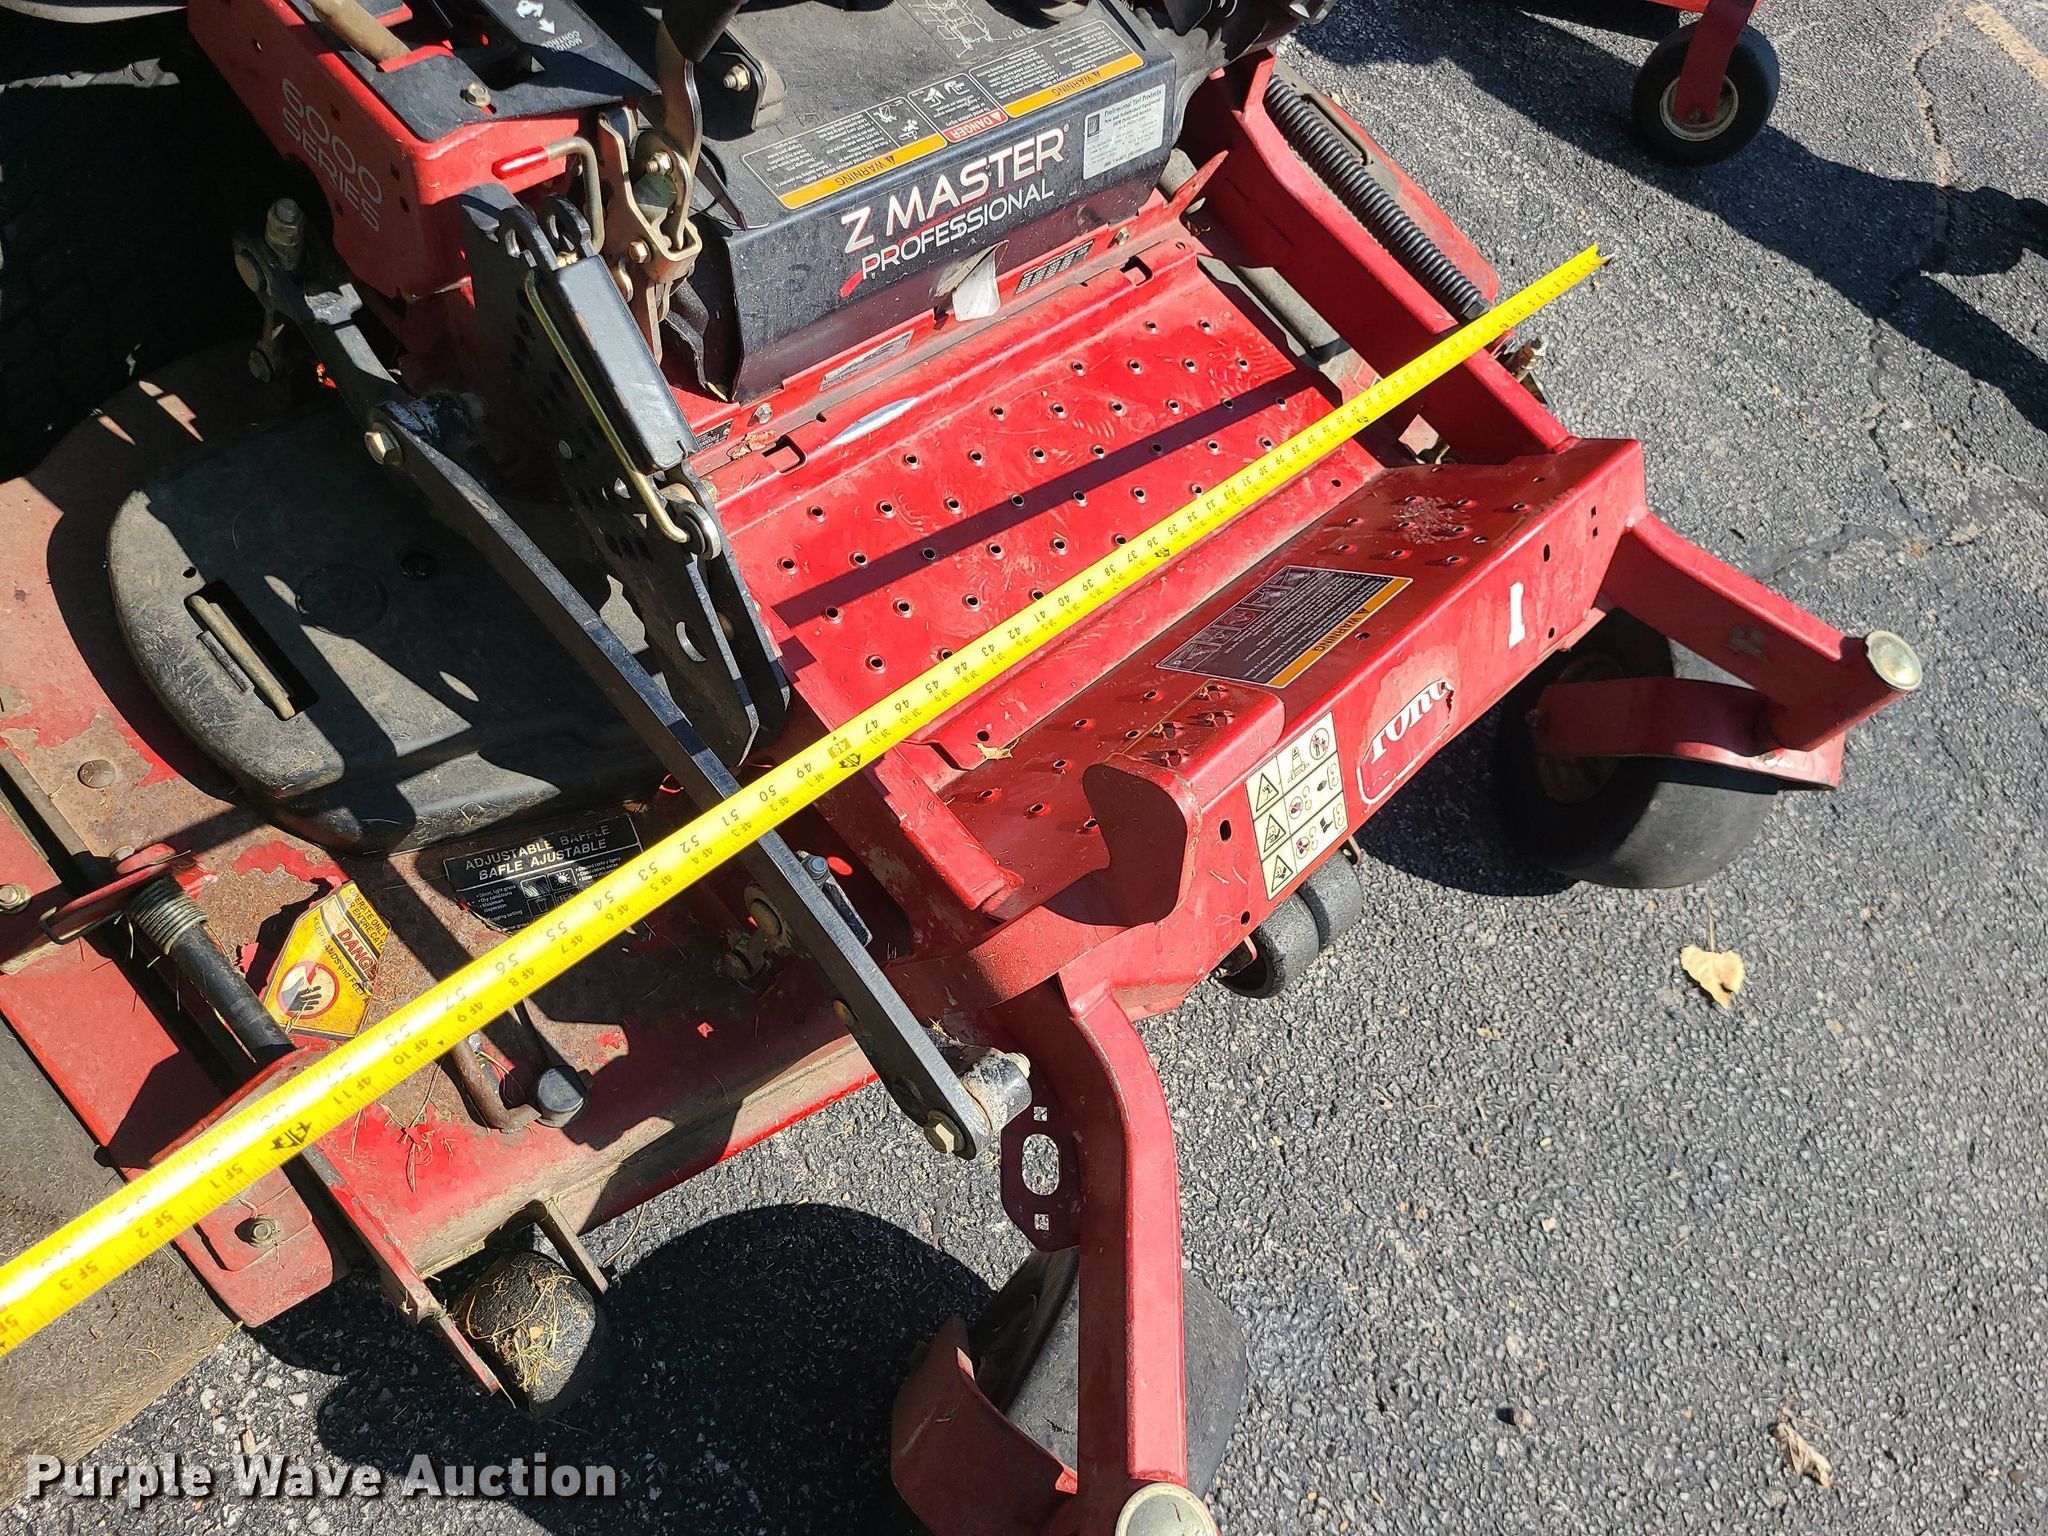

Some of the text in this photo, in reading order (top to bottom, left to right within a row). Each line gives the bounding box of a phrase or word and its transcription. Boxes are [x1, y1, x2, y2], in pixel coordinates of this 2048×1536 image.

[1050, 74, 1094, 96] WARNING
[949, 115, 993, 140] DANGER
[282, 78, 383, 205] 6000
[282, 106, 380, 232] SERIES
[833, 160, 886, 186] WARNING
[841, 128, 1065, 253] Z MASTER
[862, 178, 1054, 279] PROFESSIONAL
[1204, 498, 1216, 510] 33
[1185, 511, 1198, 522] 34
[1166, 523, 1179, 535] 35
[1145, 536, 1158, 548] 36
[1124, 549, 1138, 562] 37
[1102, 563, 1116, 576] 38
[1080, 578, 1094, 591] 39
[1056, 593, 1071, 607] 40
[1033, 609, 1047, 622] 41
[1508, 581, 1525, 649] 1
[1006, 625, 1022, 639] 42
[1311, 616, 1361, 651] WARNING
[980, 642, 996, 657] 43
[952, 660, 969, 675] 44
[967, 670, 978, 680] 3F
[923, 678, 940, 693] 45
[939, 688, 950, 698] 3F
[893, 697, 911, 713] 46
[910, 707, 921, 718] 3F
[861, 718, 880, 734] 47
[899, 713, 912, 725] 10
[869, 734, 880, 745] 11
[878, 728, 890, 738] 3F
[830, 740, 848, 756] 48
[794, 761, 814, 779] 49
[813, 771, 824, 782] 4F
[757, 784, 778, 802] 50
[777, 794, 789, 806] 4F
[768, 803, 777, 812] 2
[720, 808, 741, 827] 51
[730, 828, 739, 838] 3
[738, 819, 752, 832] 4F
[464, 824, 610, 870] ADJUSTABLE BAFFLE
[678, 833, 701, 854] 52
[477, 838, 607, 880] BAFLE AJUSTABLE
[700, 845, 713, 858] 4F
[690, 855, 699, 865] 4
[636, 861, 660, 882] 53
[658, 873, 672, 886] 4F
[648, 882, 658, 893] 5
[344, 896, 354, 908] OR
[591, 889, 616, 911] 54
[348, 887, 387, 937] OPERATE ONLY
[614, 902, 629, 915] 4F
[604, 911, 615, 923] 6
[543, 920, 569, 942] 55
[567, 932, 584, 947] 4F
[557, 941, 569, 954] 7
[312, 916, 365, 997] KEEP HANDS and FEET
[493, 951, 520, 976] 56
[518, 964, 536, 980] 4F
[507, 975, 519, 988] 8
[439, 986, 467, 1010] 57
[466, 999, 485, 1016] 4F
[454, 1010, 467, 1023] 9
[411, 1036, 430, 1053] 4F
[391, 1048, 411, 1066] 10
[353, 1073, 373, 1092] 4F
[331, 1087, 353, 1106] 11
[221, 1161, 243, 1181] 5F
[208, 1177, 220, 1190] 1
[150, 1208, 173, 1229] 5F
[134, 1224, 150, 1240] 2
[75, 1259, 98, 1280] 5F
[57, 1276, 73, 1292] 3
